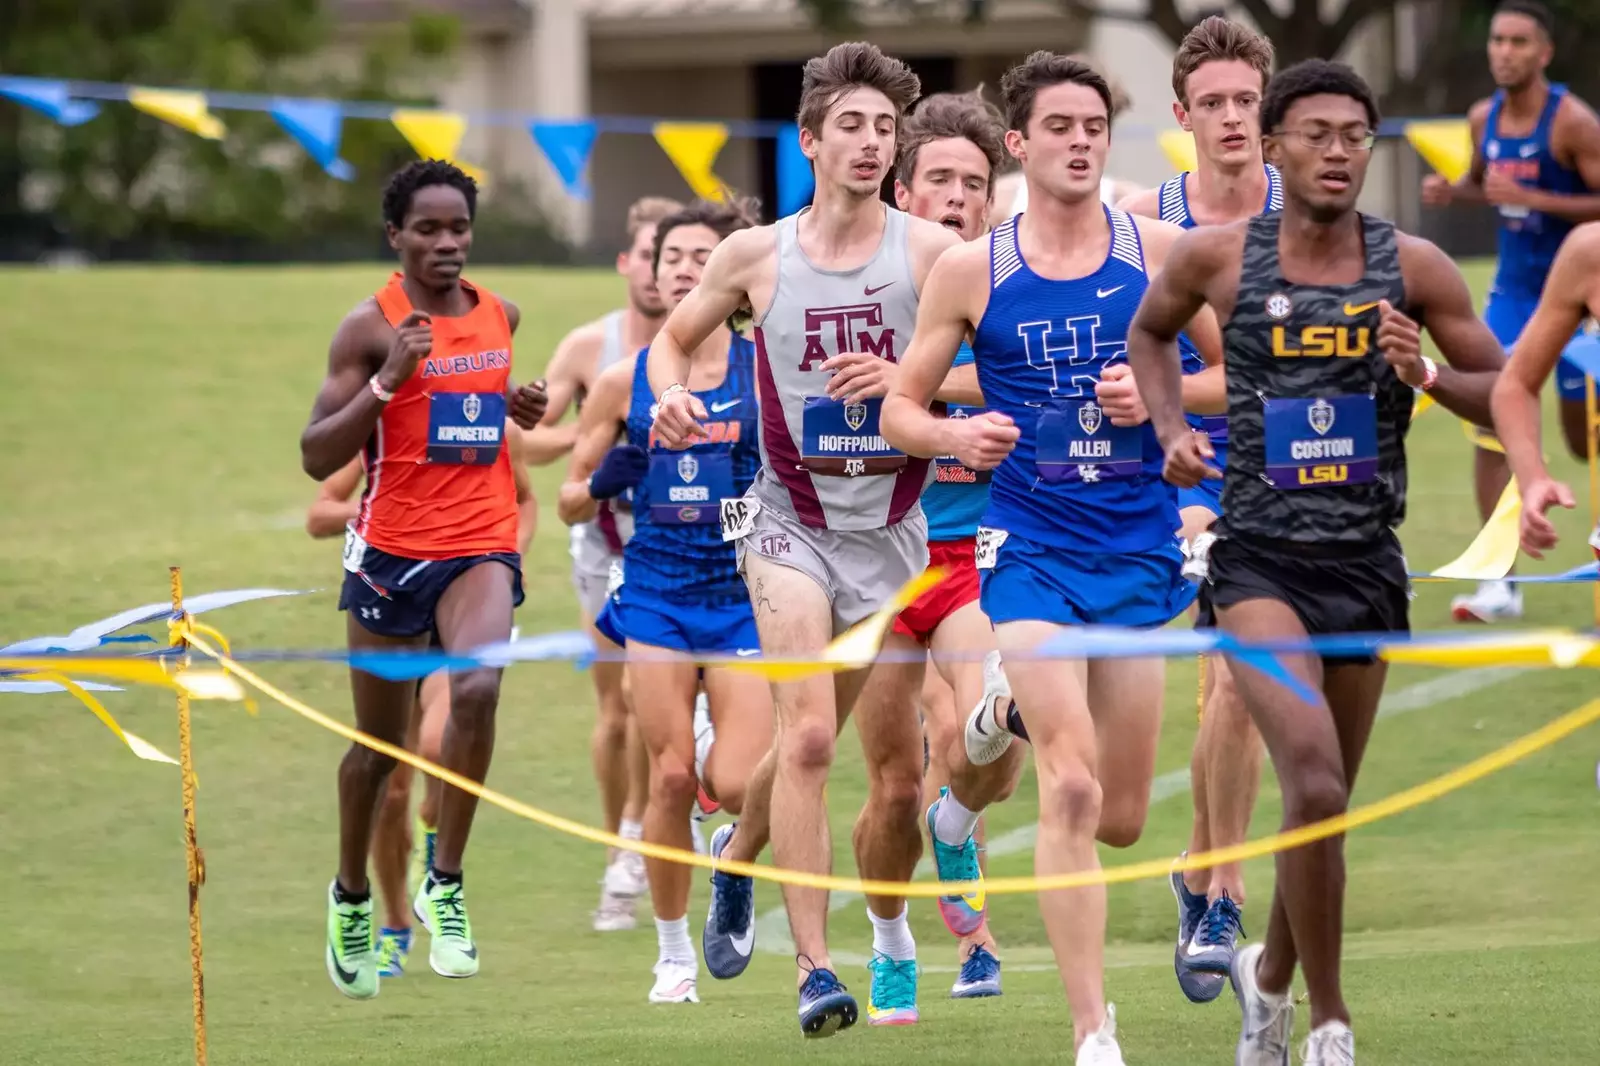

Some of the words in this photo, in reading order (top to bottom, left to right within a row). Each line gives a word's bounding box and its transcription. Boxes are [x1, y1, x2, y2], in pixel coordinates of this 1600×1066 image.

[1272, 326, 1369, 357] LSU
[421, 349, 510, 378] AUBURN
[1069, 440, 1111, 457] ALLEN
[1291, 438, 1354, 460] COSTON
[1298, 465, 1348, 485] LSU
[668, 486, 709, 502] GEIGER
